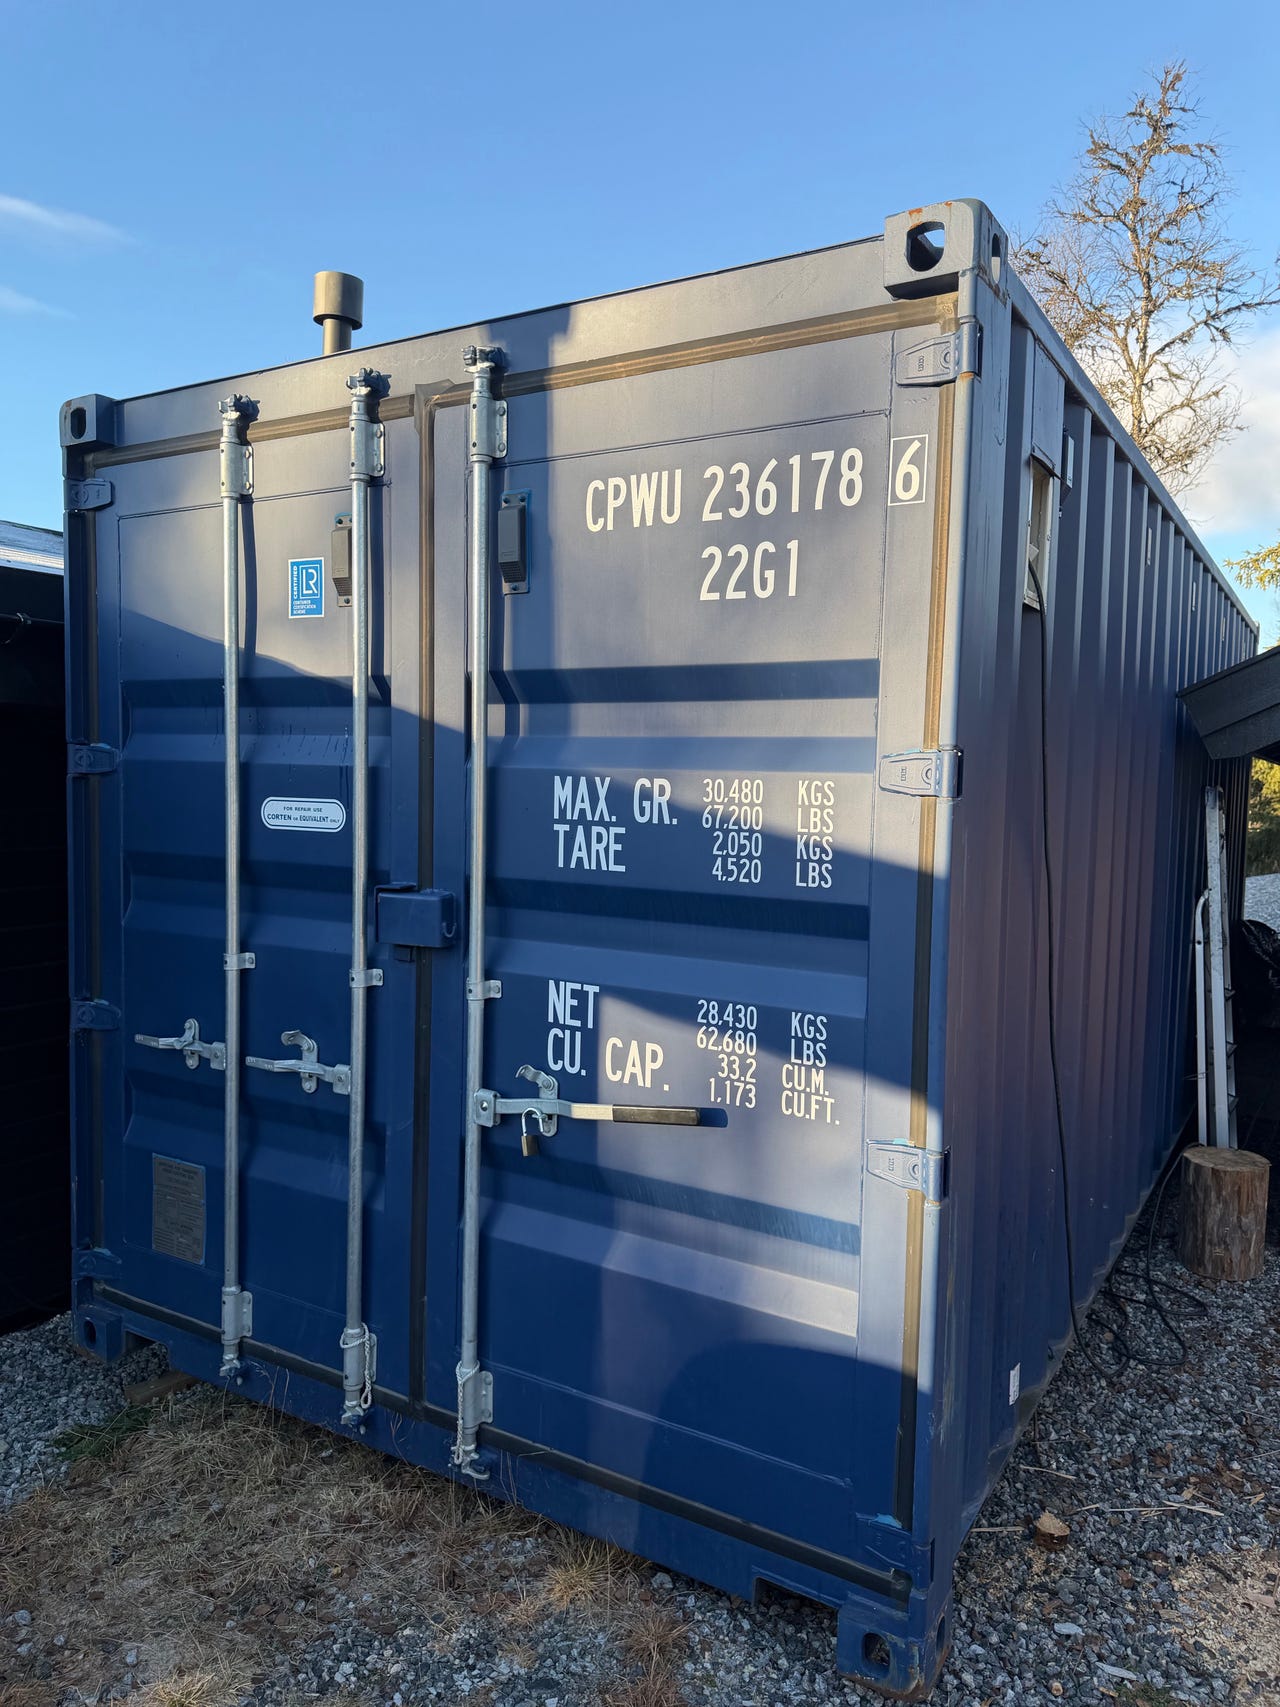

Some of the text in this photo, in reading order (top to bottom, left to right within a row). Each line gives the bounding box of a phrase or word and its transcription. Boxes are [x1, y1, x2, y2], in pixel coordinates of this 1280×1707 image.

[585, 439, 922, 533] CPWU 236178 6
[302, 568, 318, 594] LR
[699, 539, 799, 601] 22G1
[553, 775, 678, 825] MAX. GR.
[702, 778, 835, 806] 30,480 KGS
[267, 813, 292, 821] CORTEN
[299, 814, 329, 822] EQUIVALENT
[702, 805, 834, 833] 67,200 LBS
[553, 824, 626, 872] TARE
[712, 831, 833, 861] 2,050 KGS
[712, 858, 832, 888] 4,520 LBS
[548, 979, 600, 1029] NET
[697, 999, 828, 1041] 28,430 KGS
[547, 1028, 670, 1091] CU. CAP.
[696, 1026, 827, 1068] 62,680 LBS
[718, 1053, 830, 1095] 33.2 CU.M.
[709, 1077, 840, 1125] 1,173 CU.FT.
